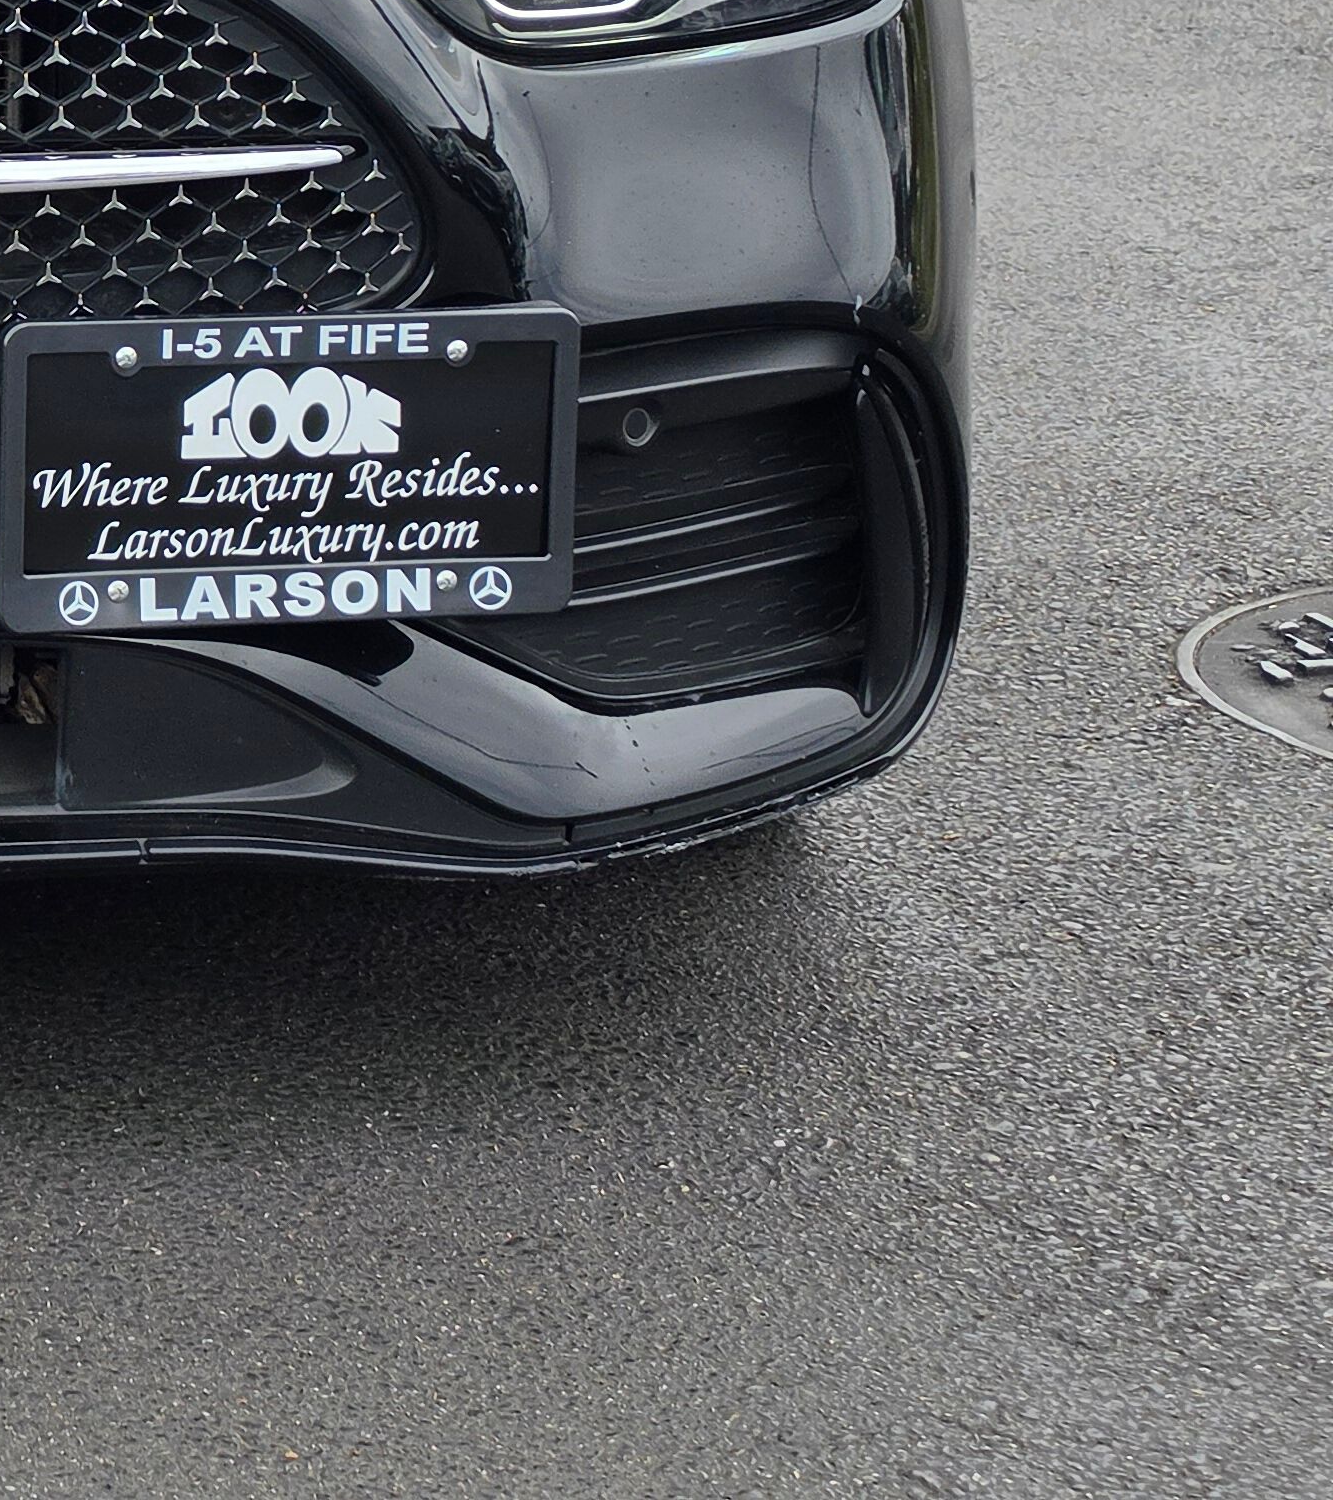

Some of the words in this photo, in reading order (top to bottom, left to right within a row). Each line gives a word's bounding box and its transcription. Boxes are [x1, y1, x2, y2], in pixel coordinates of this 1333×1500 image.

[161, 328, 222, 360] I-5
[234, 325, 303, 357] AT
[318, 322, 431, 355] FIFE
[31, 461, 169, 509] Where
[178, 465, 334, 518] Luxury
[344, 451, 540, 507] Resides...
[86, 516, 480, 563] LarsonLuxury.com
[138, 567, 432, 623] LARSON
